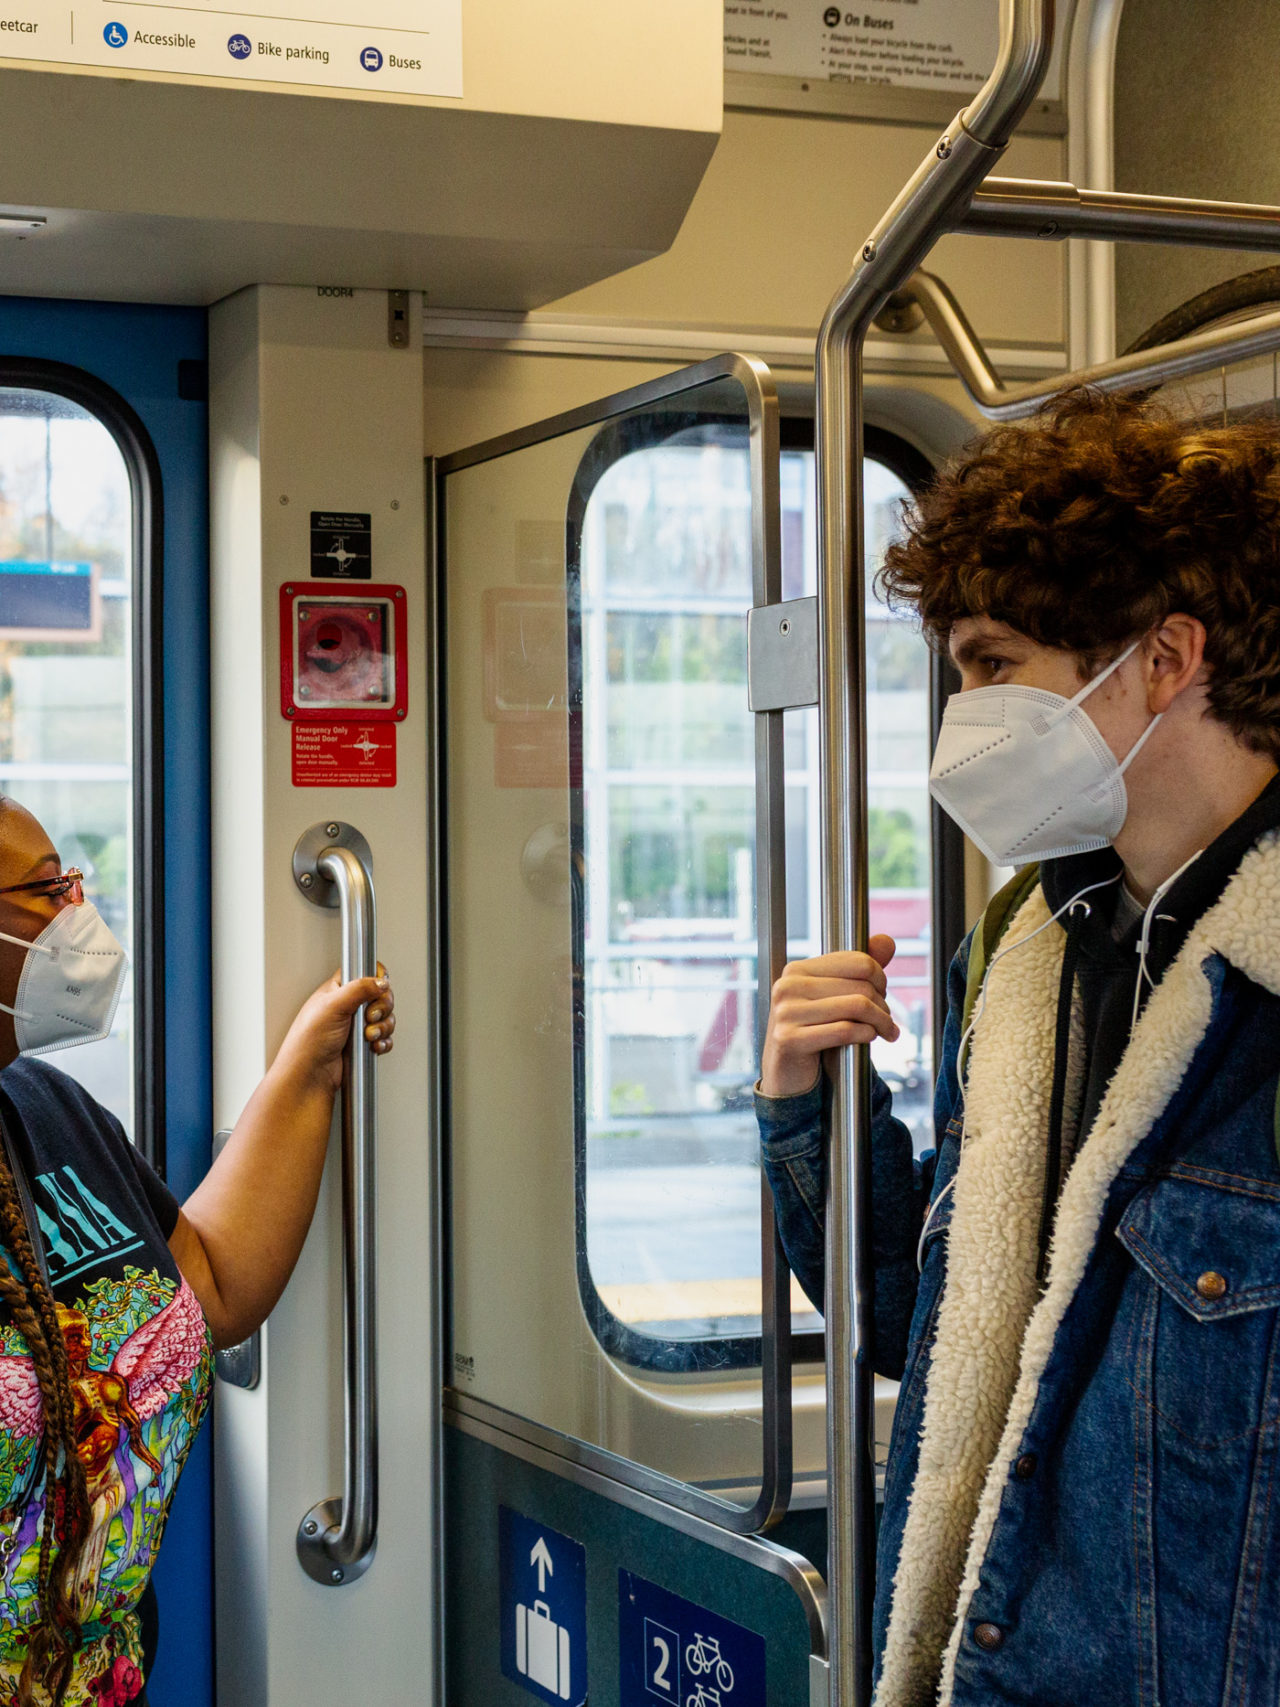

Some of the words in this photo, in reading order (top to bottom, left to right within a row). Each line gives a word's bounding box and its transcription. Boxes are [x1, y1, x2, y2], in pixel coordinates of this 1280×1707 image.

[844, 13, 860, 26] On
[864, 14, 894, 30] Buses
[134, 30, 196, 49] Accessible
[258, 42, 282, 57] Bike
[286, 45, 330, 64] parking
[389, 55, 422, 70] Buses
[296, 726, 331, 735] Emergency
[333, 726, 348, 735] Only
[296, 743, 320, 751] Release
[653, 1636, 671, 1692] 2
